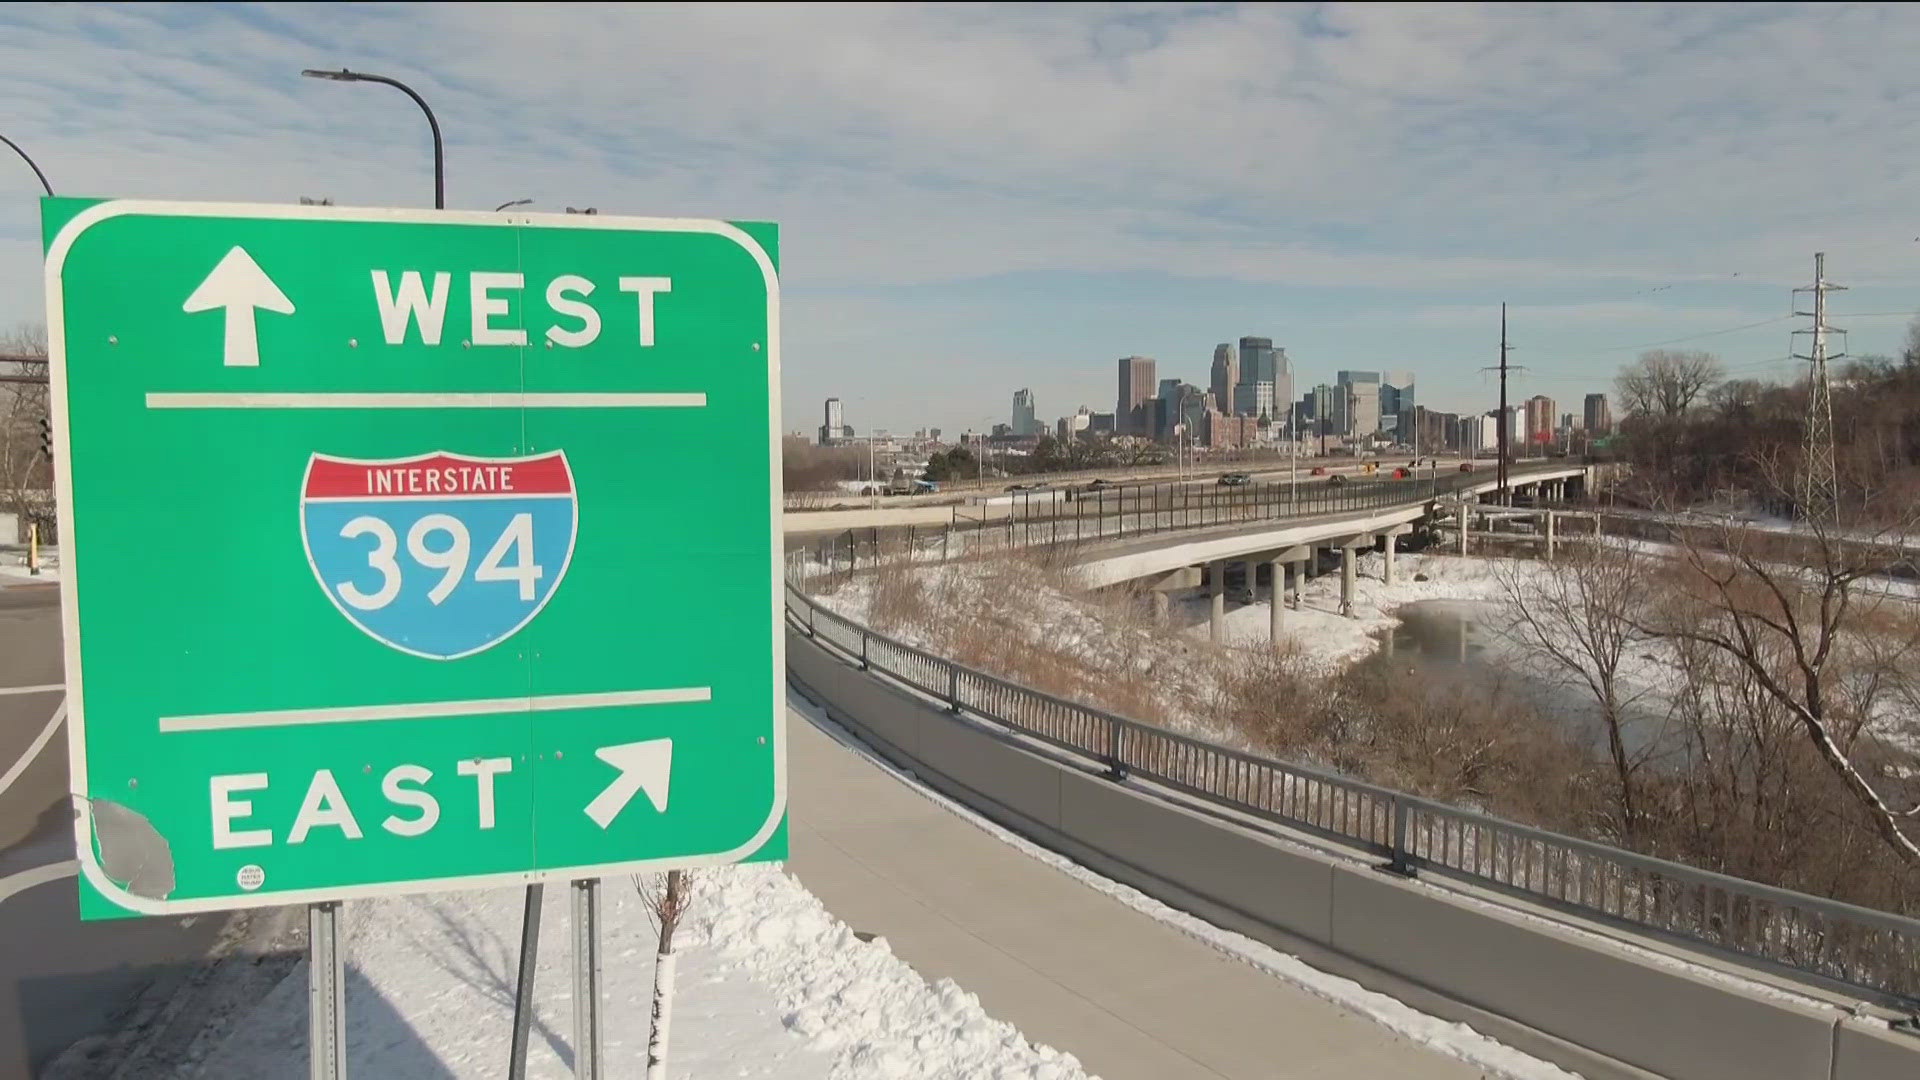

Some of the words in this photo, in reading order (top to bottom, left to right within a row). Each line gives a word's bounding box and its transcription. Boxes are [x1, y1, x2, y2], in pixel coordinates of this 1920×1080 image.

[371, 271, 672, 347] WEST
[367, 467, 514, 494] INTERSTATE
[336, 513, 543, 611] 394
[210, 757, 512, 850] EAST
